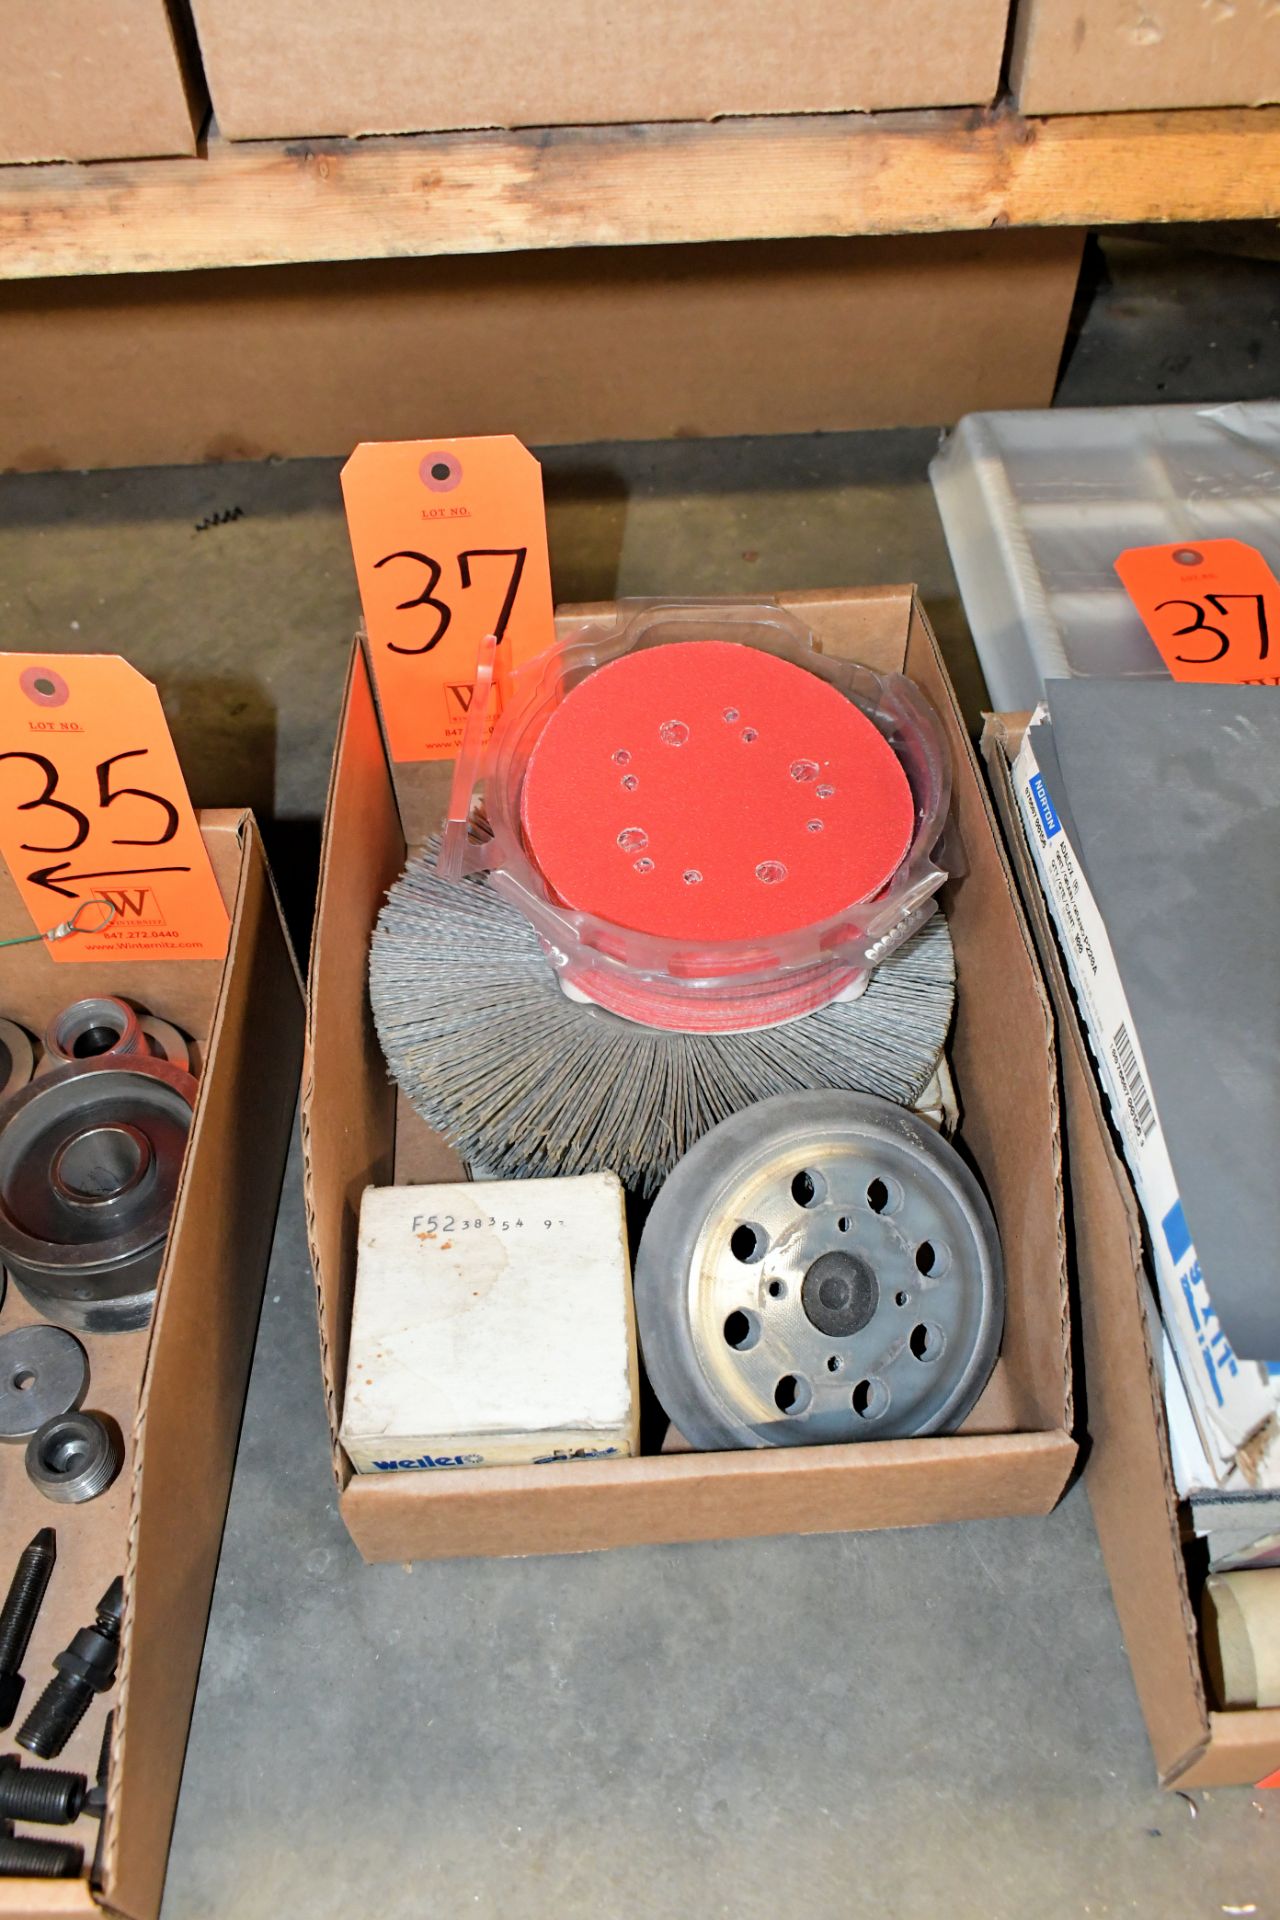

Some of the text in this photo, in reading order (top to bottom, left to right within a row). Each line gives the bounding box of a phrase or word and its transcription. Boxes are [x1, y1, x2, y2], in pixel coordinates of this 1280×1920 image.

[421, 506, 471, 518] LOT NO.
[373, 547, 527, 655] 37
[1154, 593, 1269, 663] 37
[28, 721, 83, 730] LOT NO.
[0, 748, 179, 853] 35
[1034, 778, 1056, 831] NORTON
[94, 888, 149, 918] W
[84, 941, 204, 952] www.Winternitz.com
[103, 930, 180, 940] 847.272.0440
